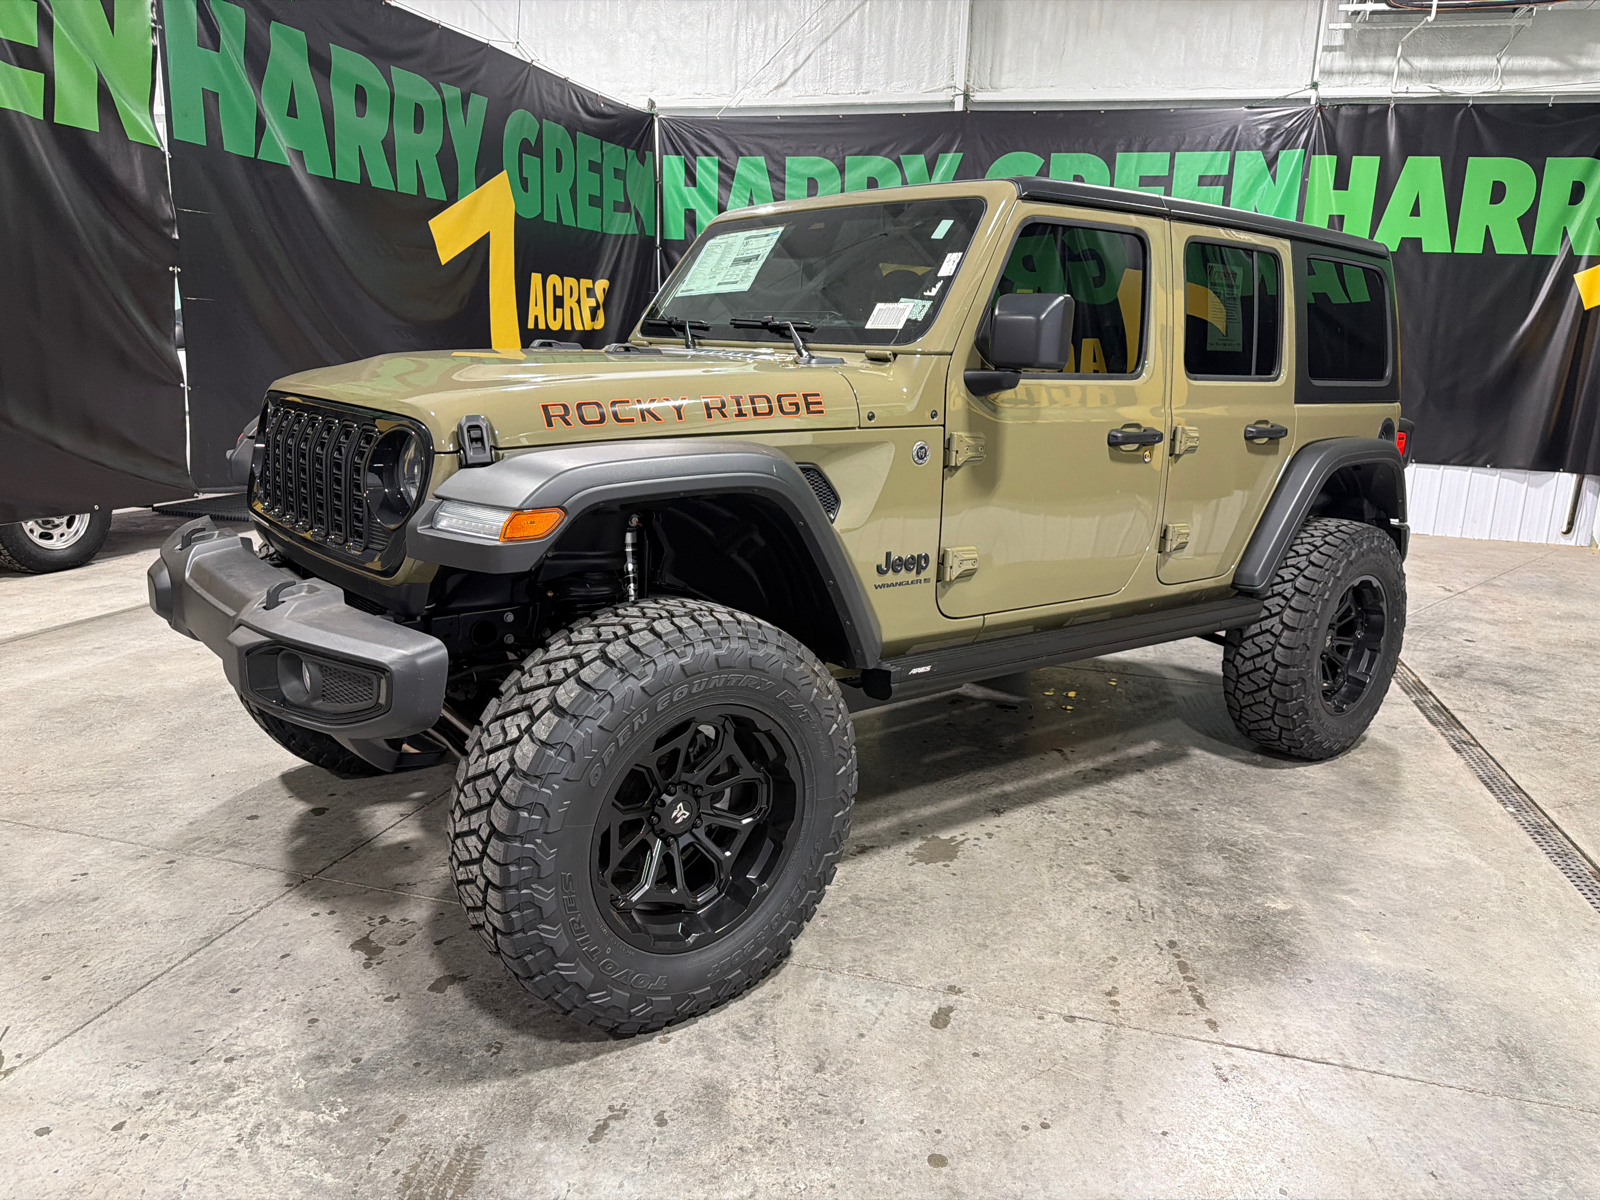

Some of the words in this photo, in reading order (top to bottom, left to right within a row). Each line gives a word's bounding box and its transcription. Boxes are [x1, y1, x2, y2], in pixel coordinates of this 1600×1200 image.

[162, 0, 489, 201] HARRY
[503, 108, 656, 237] GREEN
[428, 169, 522, 349] 1
[527, 272, 610, 331] ACRES
[539, 396, 690, 430] ROCKY
[700, 392, 827, 421] RIDGE
[873, 578, 923, 590] WRANGLER
[876, 550, 930, 576] Jeep
[588, 707, 649, 788] OPEN
[656, 673, 776, 712] COUNTRY
[560, 871, 602, 962] TIRES
[598, 957, 668, 991] TOYO
